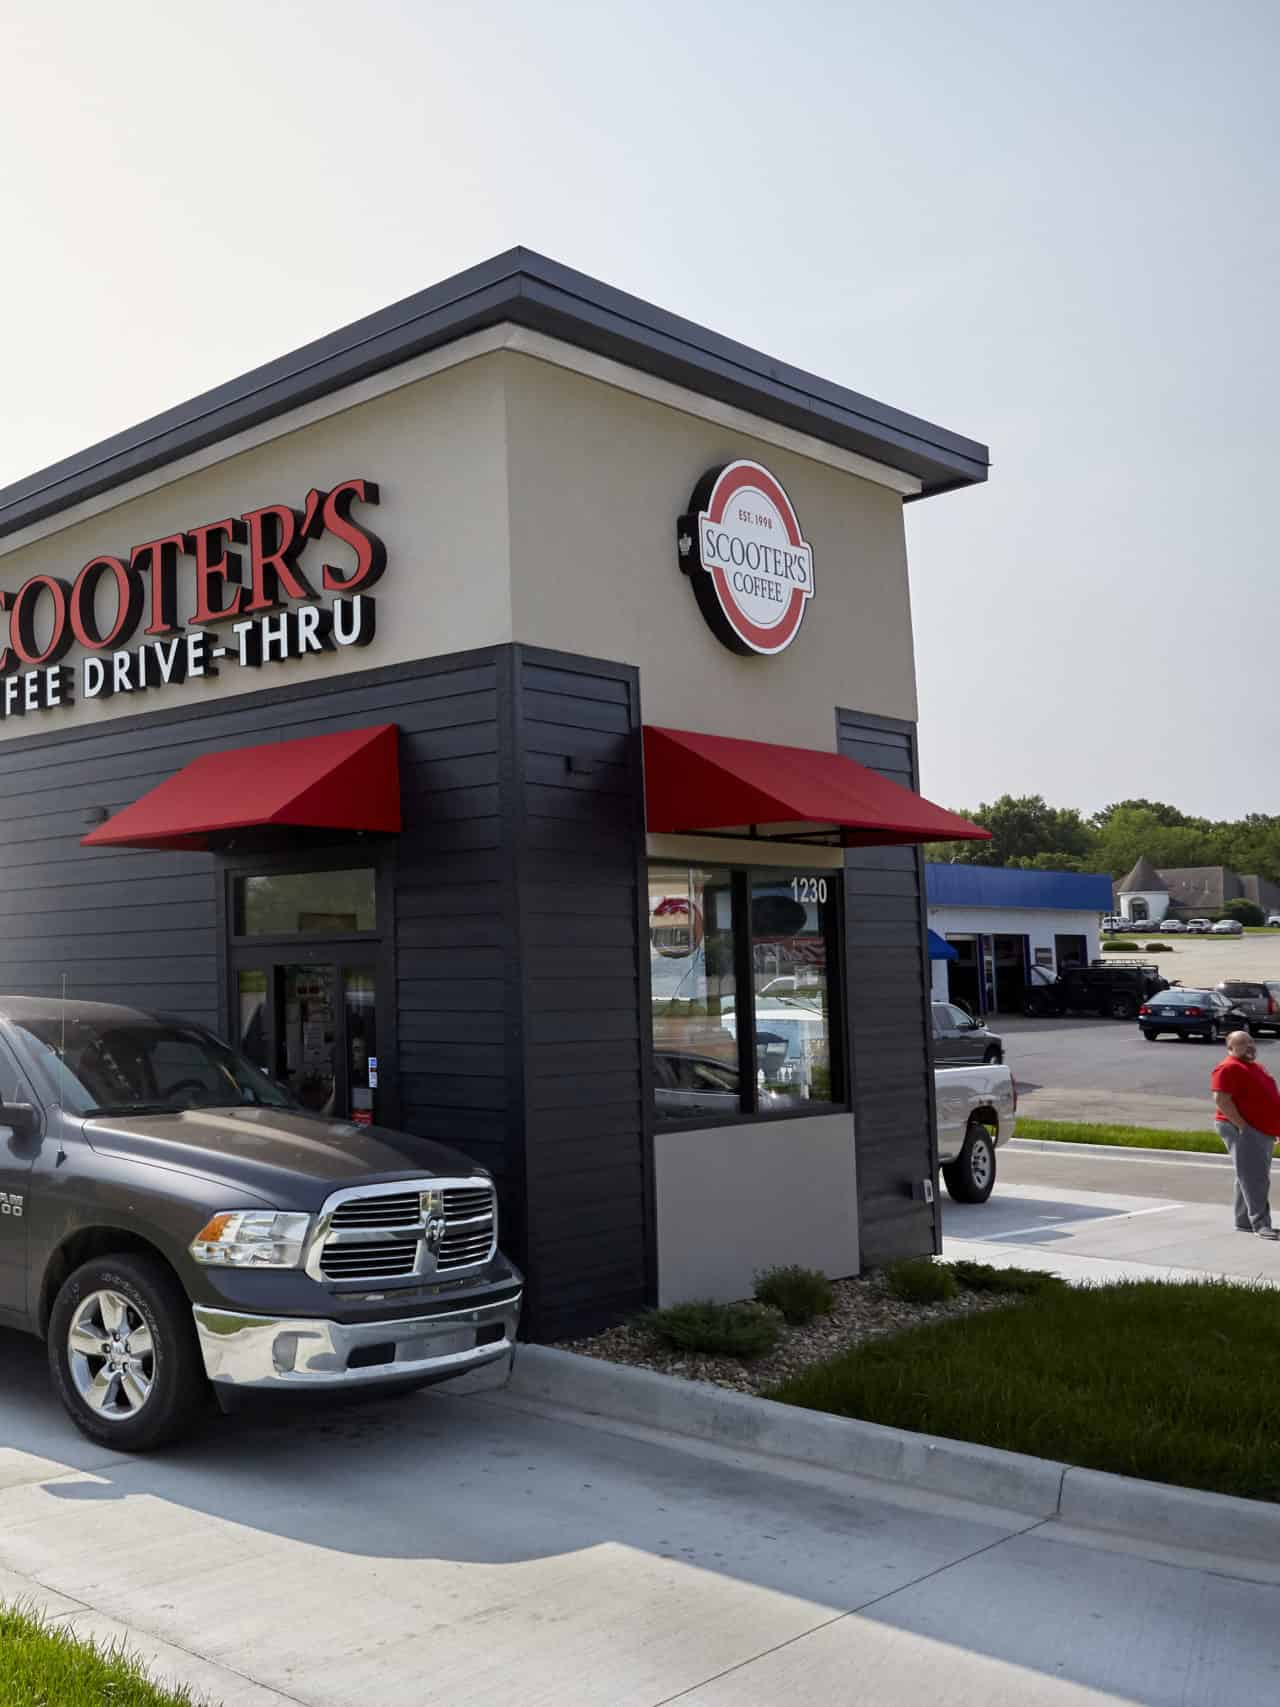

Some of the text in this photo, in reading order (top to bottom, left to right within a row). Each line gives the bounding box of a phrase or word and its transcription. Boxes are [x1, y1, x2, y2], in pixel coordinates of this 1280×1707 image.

[706, 529, 807, 584] SCOOTER'S
[733, 571, 783, 603] COFFEE
[83, 594, 368, 699] DRIVE-THRU
[791, 876, 827, 904] 1230
